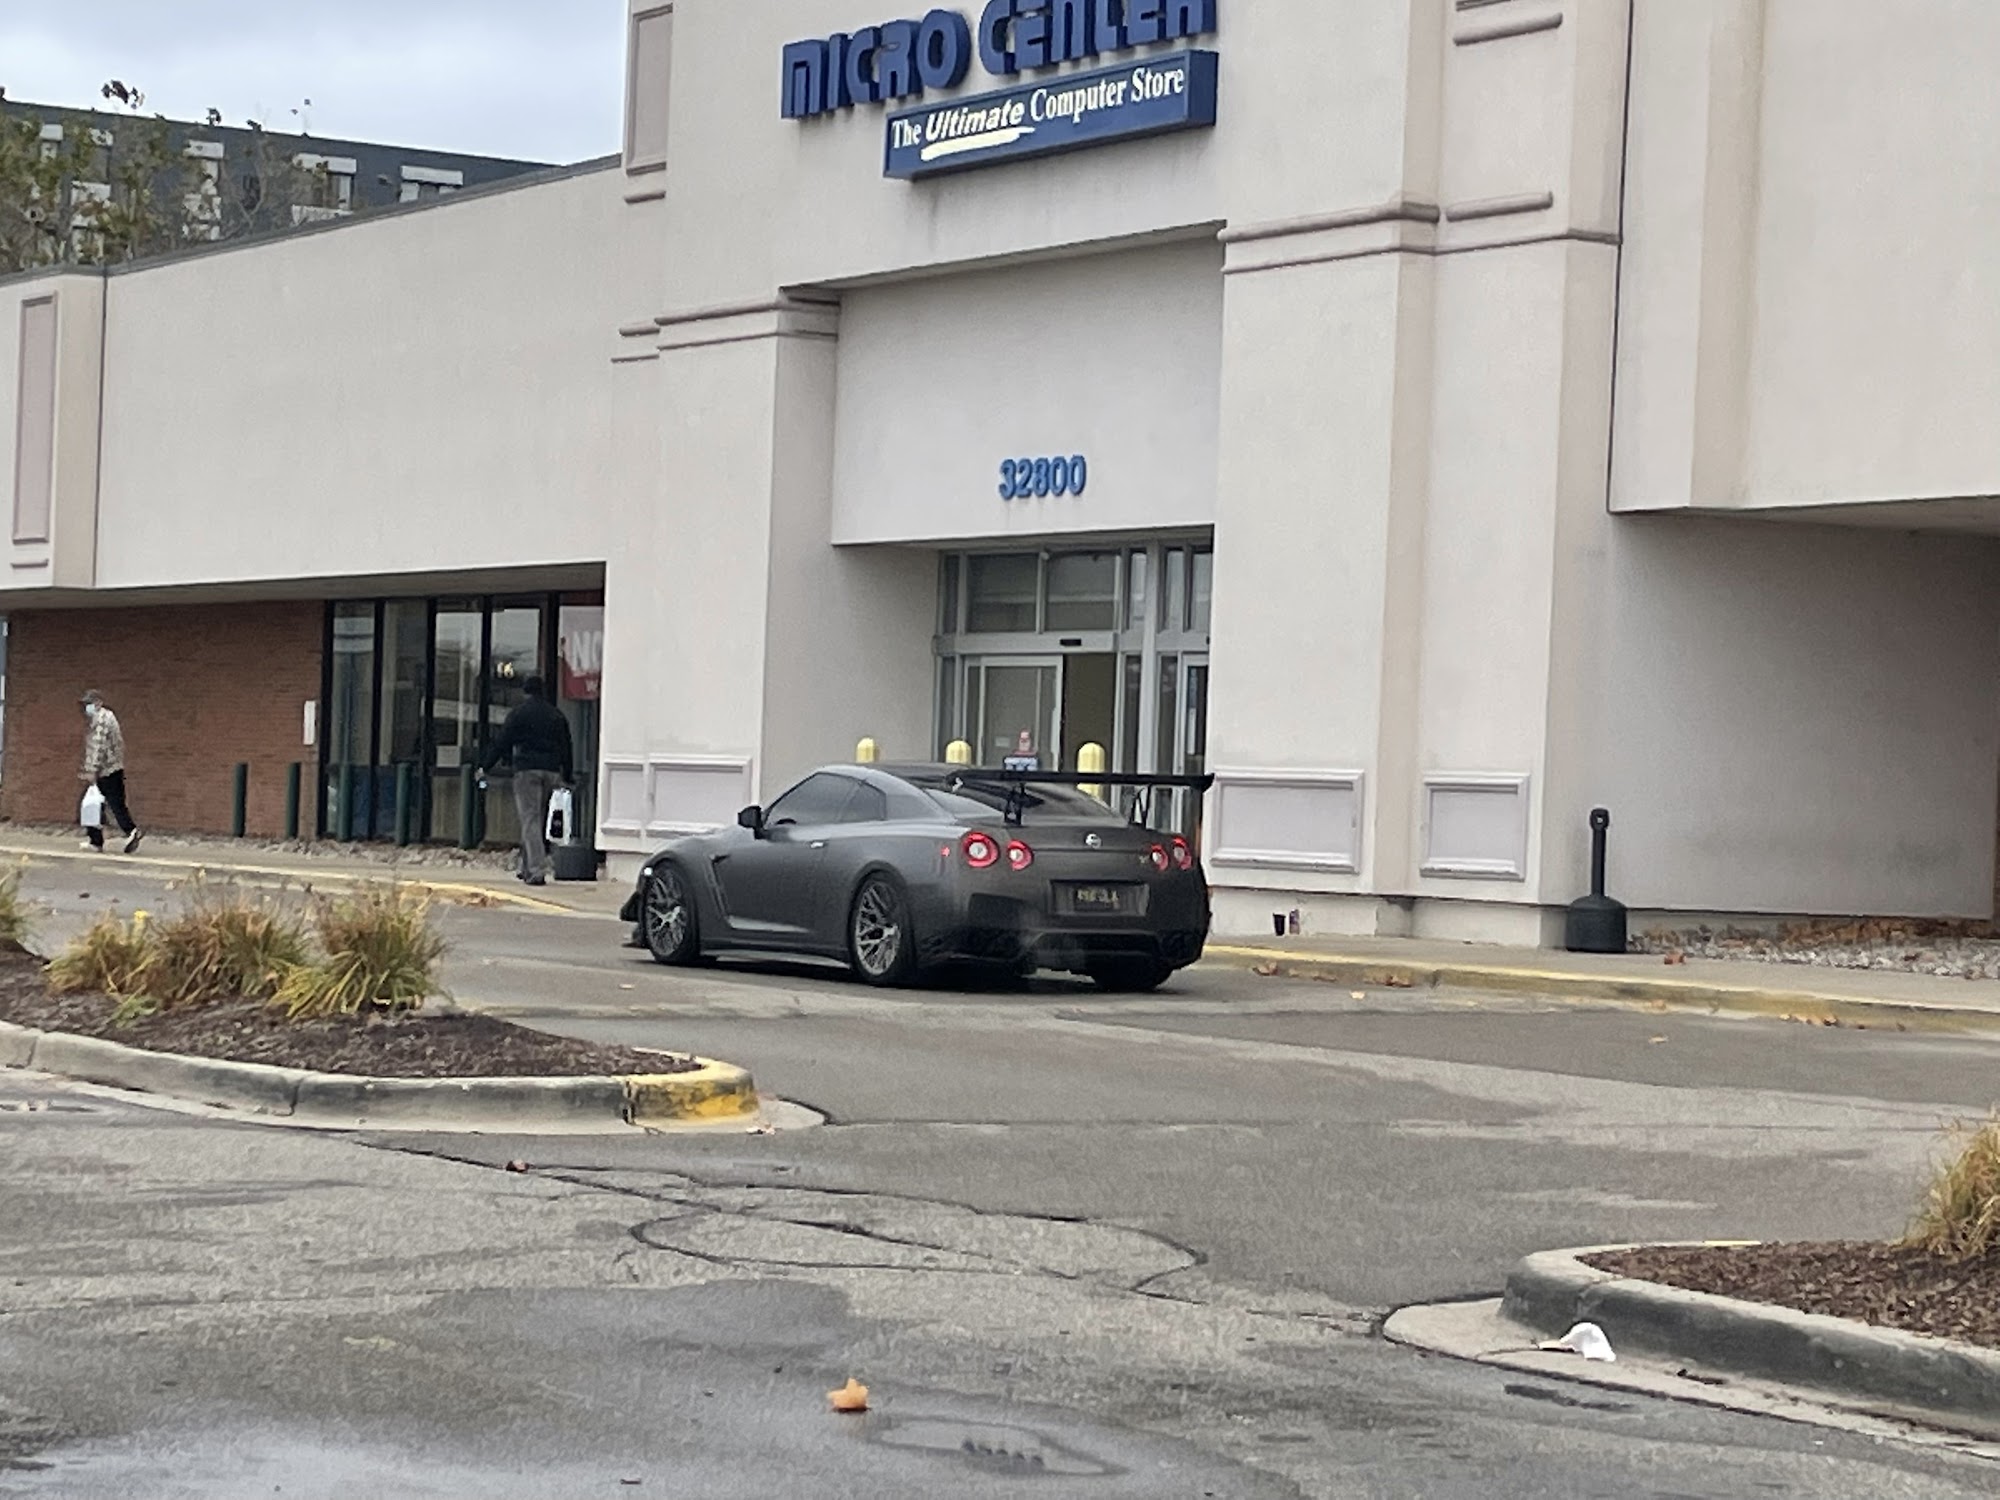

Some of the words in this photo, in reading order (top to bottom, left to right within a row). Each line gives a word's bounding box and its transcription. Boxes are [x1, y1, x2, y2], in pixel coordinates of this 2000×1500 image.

[782, 9, 969, 119] MICRO
[892, 119, 922, 149] The
[926, 99, 1025, 141] Ultimate
[1030, 88, 1128, 124] Computer
[1131, 67, 1185, 102] Store
[999, 455, 1087, 500] 32800
